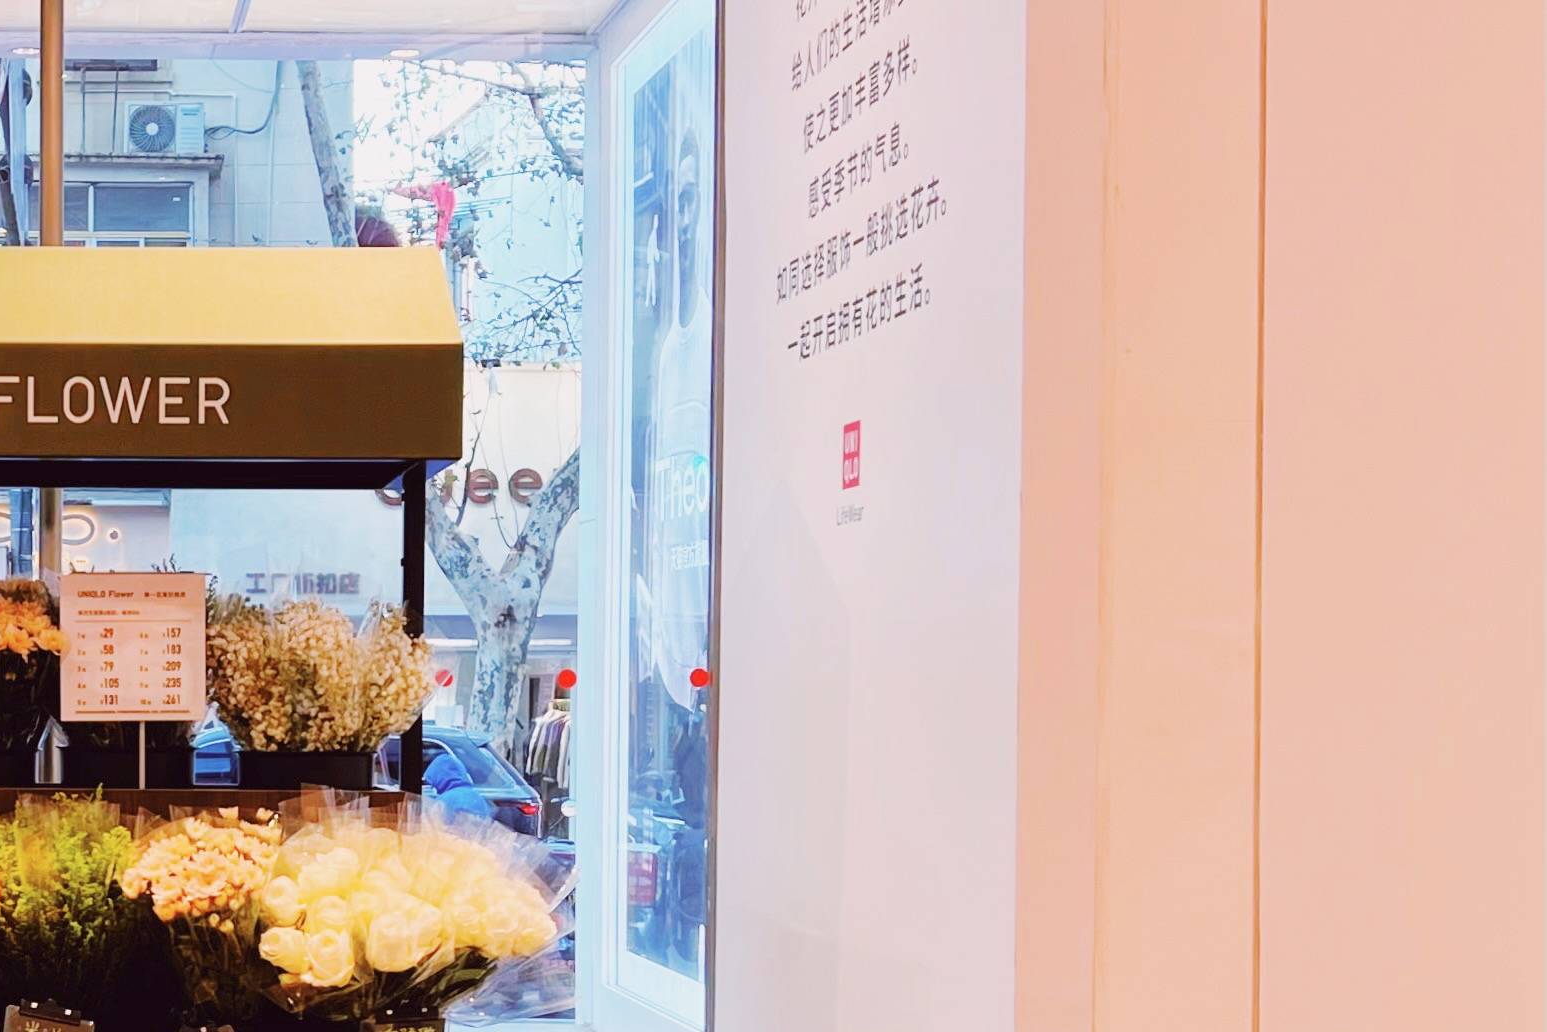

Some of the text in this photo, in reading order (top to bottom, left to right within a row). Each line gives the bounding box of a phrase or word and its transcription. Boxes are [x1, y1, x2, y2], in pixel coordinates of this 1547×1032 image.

[792, 0, 907, 91] 给人们的生活增
[804, 34, 918, 155] 使之更加丰富多样。
[808, 121, 910, 219] 感受季节的气息。
